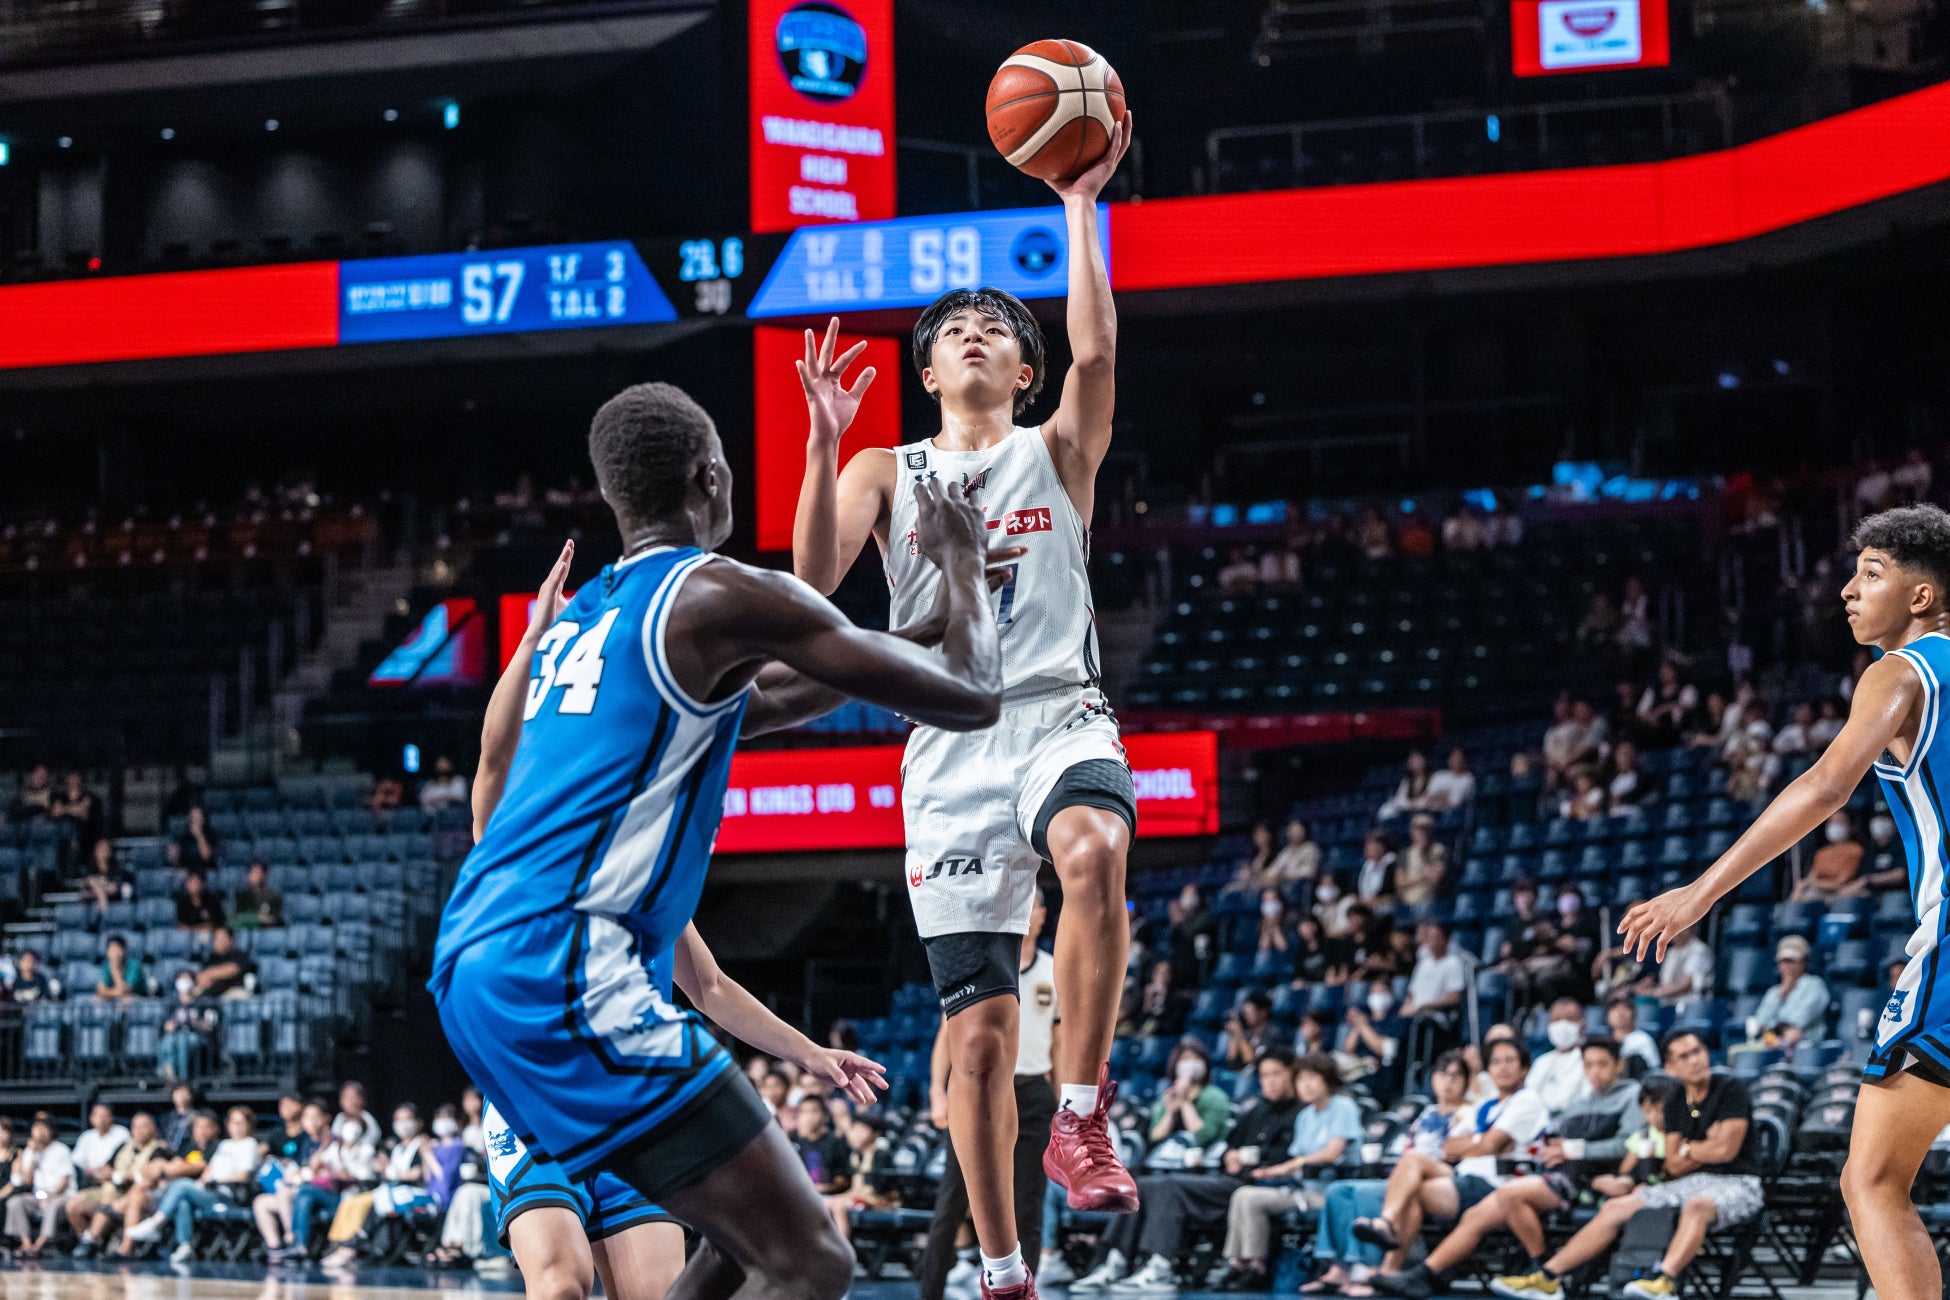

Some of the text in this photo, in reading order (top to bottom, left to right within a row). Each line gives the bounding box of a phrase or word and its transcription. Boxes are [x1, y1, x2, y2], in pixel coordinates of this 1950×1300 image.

[909, 226, 981, 294] 59
[1006, 509, 1051, 533] ネット
[523, 606, 621, 722] 34
[750, 784, 814, 815] KINGS
[926, 858, 984, 880] JTA
